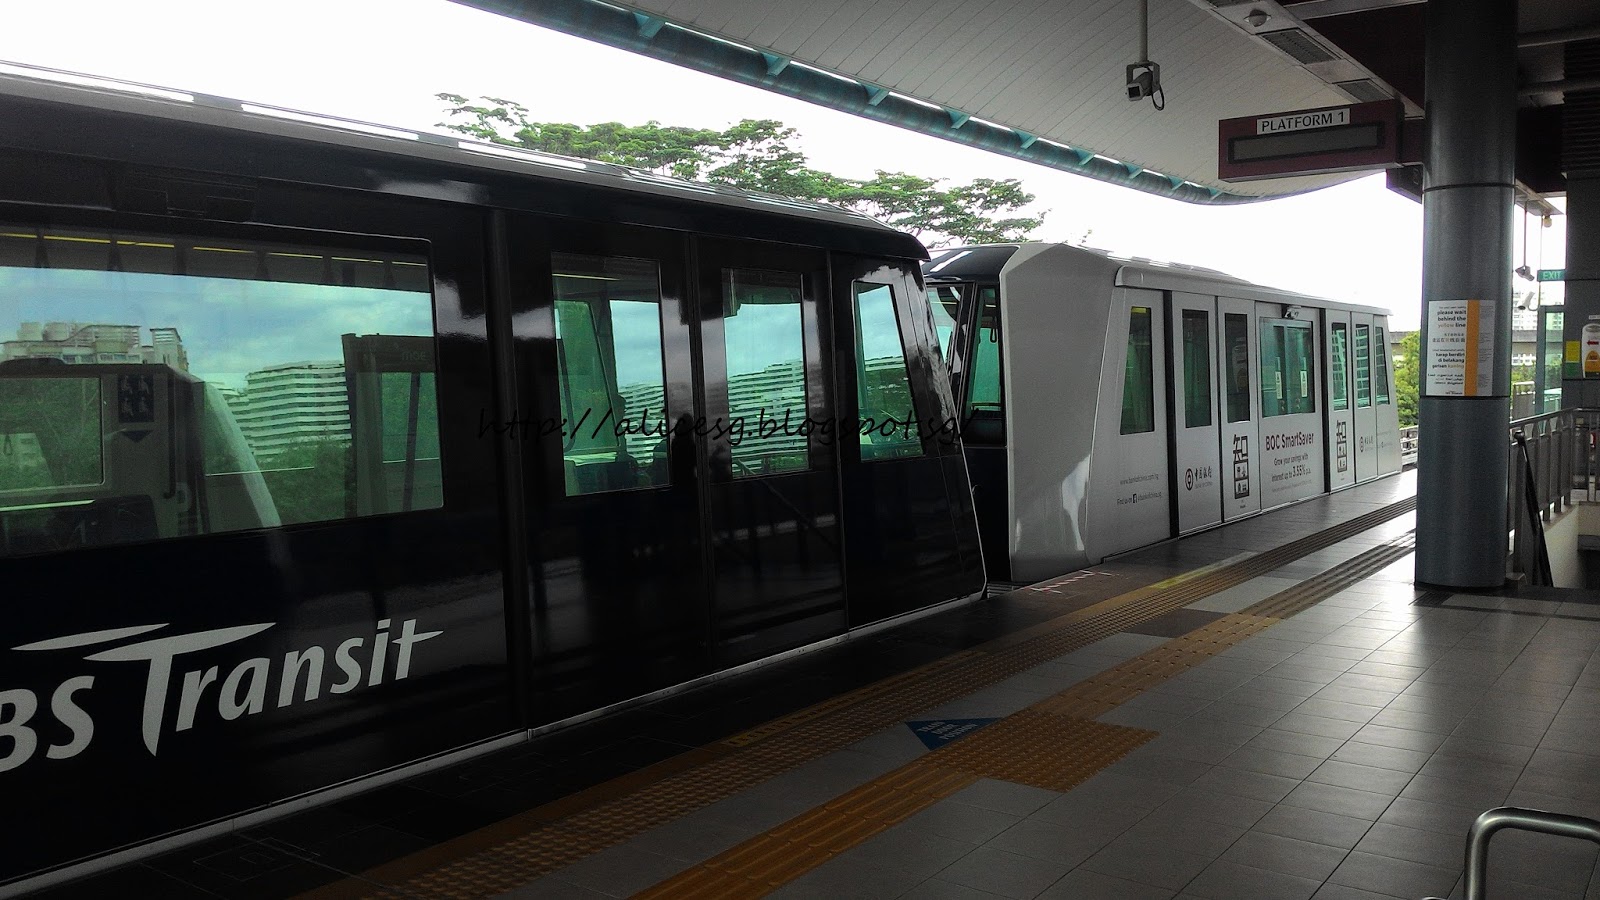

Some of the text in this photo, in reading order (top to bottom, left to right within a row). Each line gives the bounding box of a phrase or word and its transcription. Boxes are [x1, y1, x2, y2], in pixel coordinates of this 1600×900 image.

[1261, 111, 1345, 132] PLATFORM 1
[1543, 270, 1562, 280] EXIT
[1265, 431, 1314, 451] BOC SmartSaver
[83, 618, 444, 757] Transit
